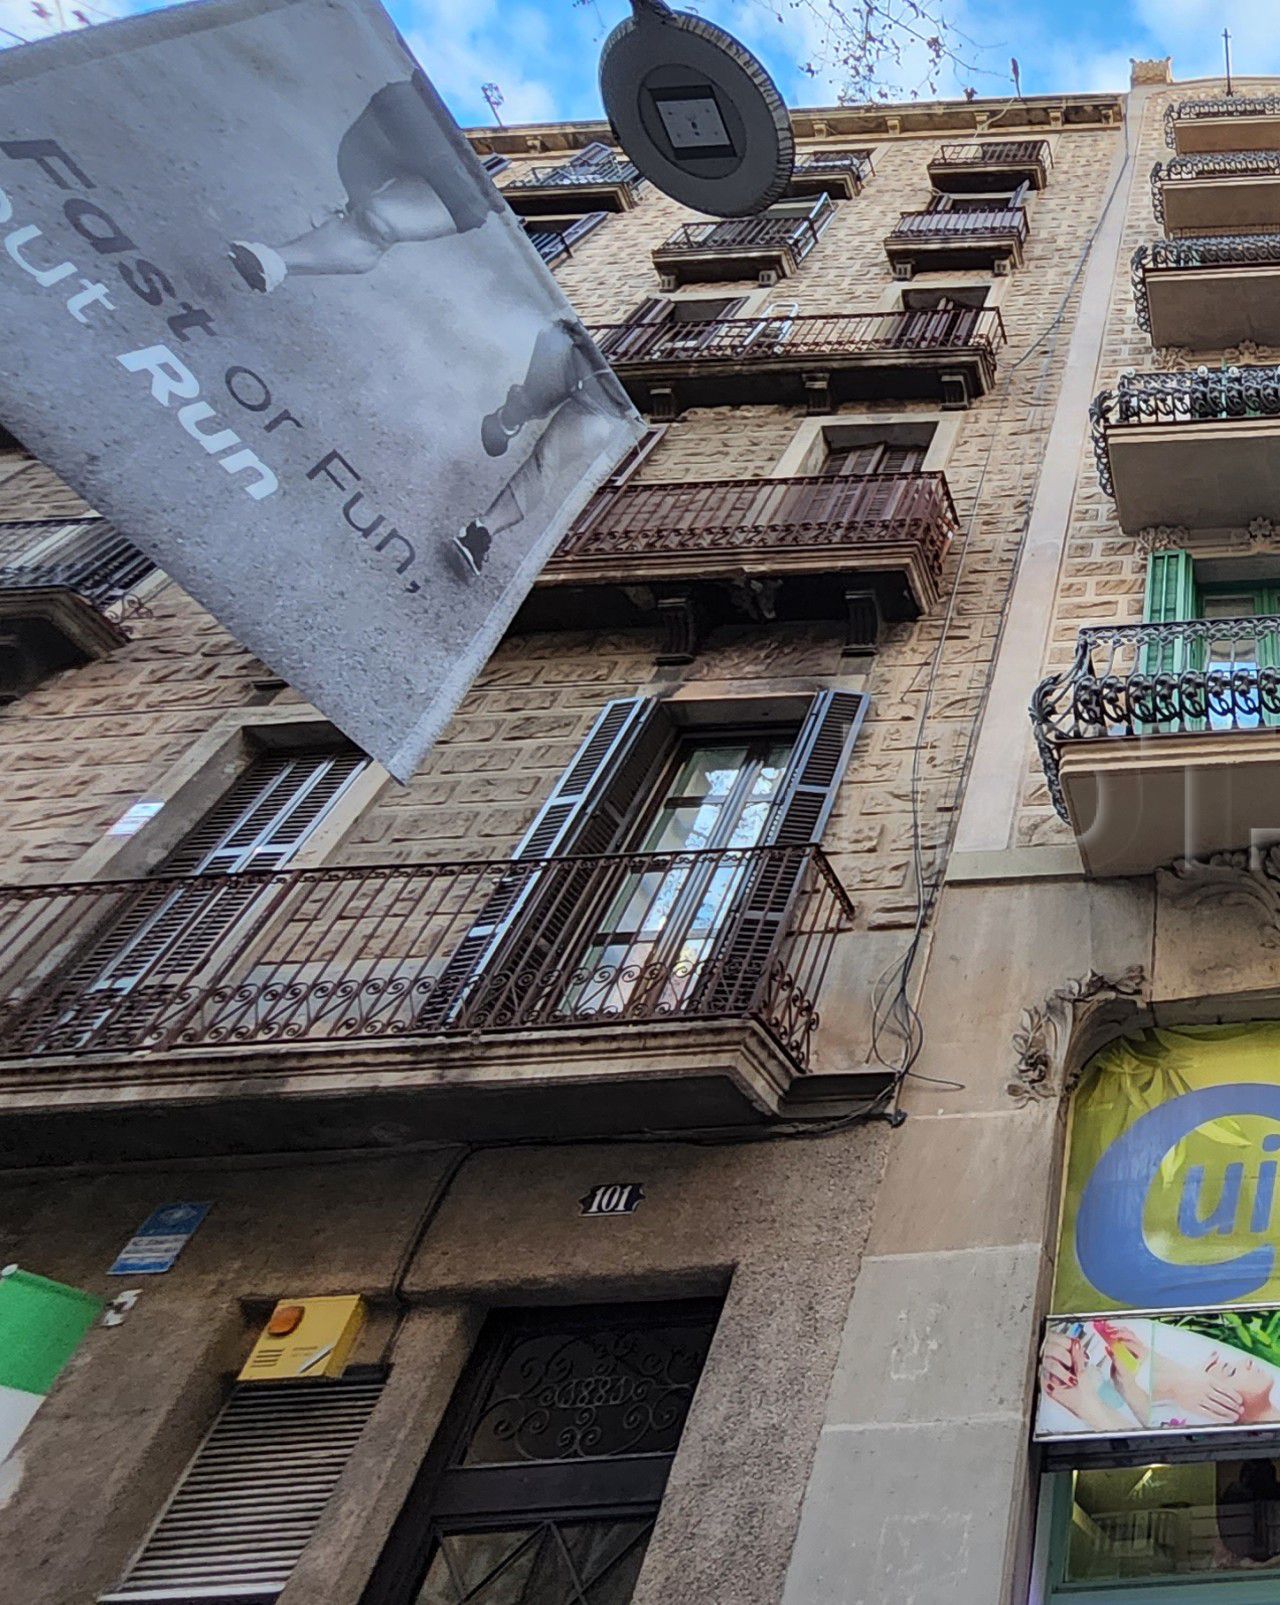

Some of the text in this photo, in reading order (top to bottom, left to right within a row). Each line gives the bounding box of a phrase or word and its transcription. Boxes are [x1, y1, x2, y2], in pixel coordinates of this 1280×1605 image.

[0, 139, 422, 594] Fast Or Fun,
[116, 344, 279, 500] Run
[588, 1186, 632, 1212] 101
